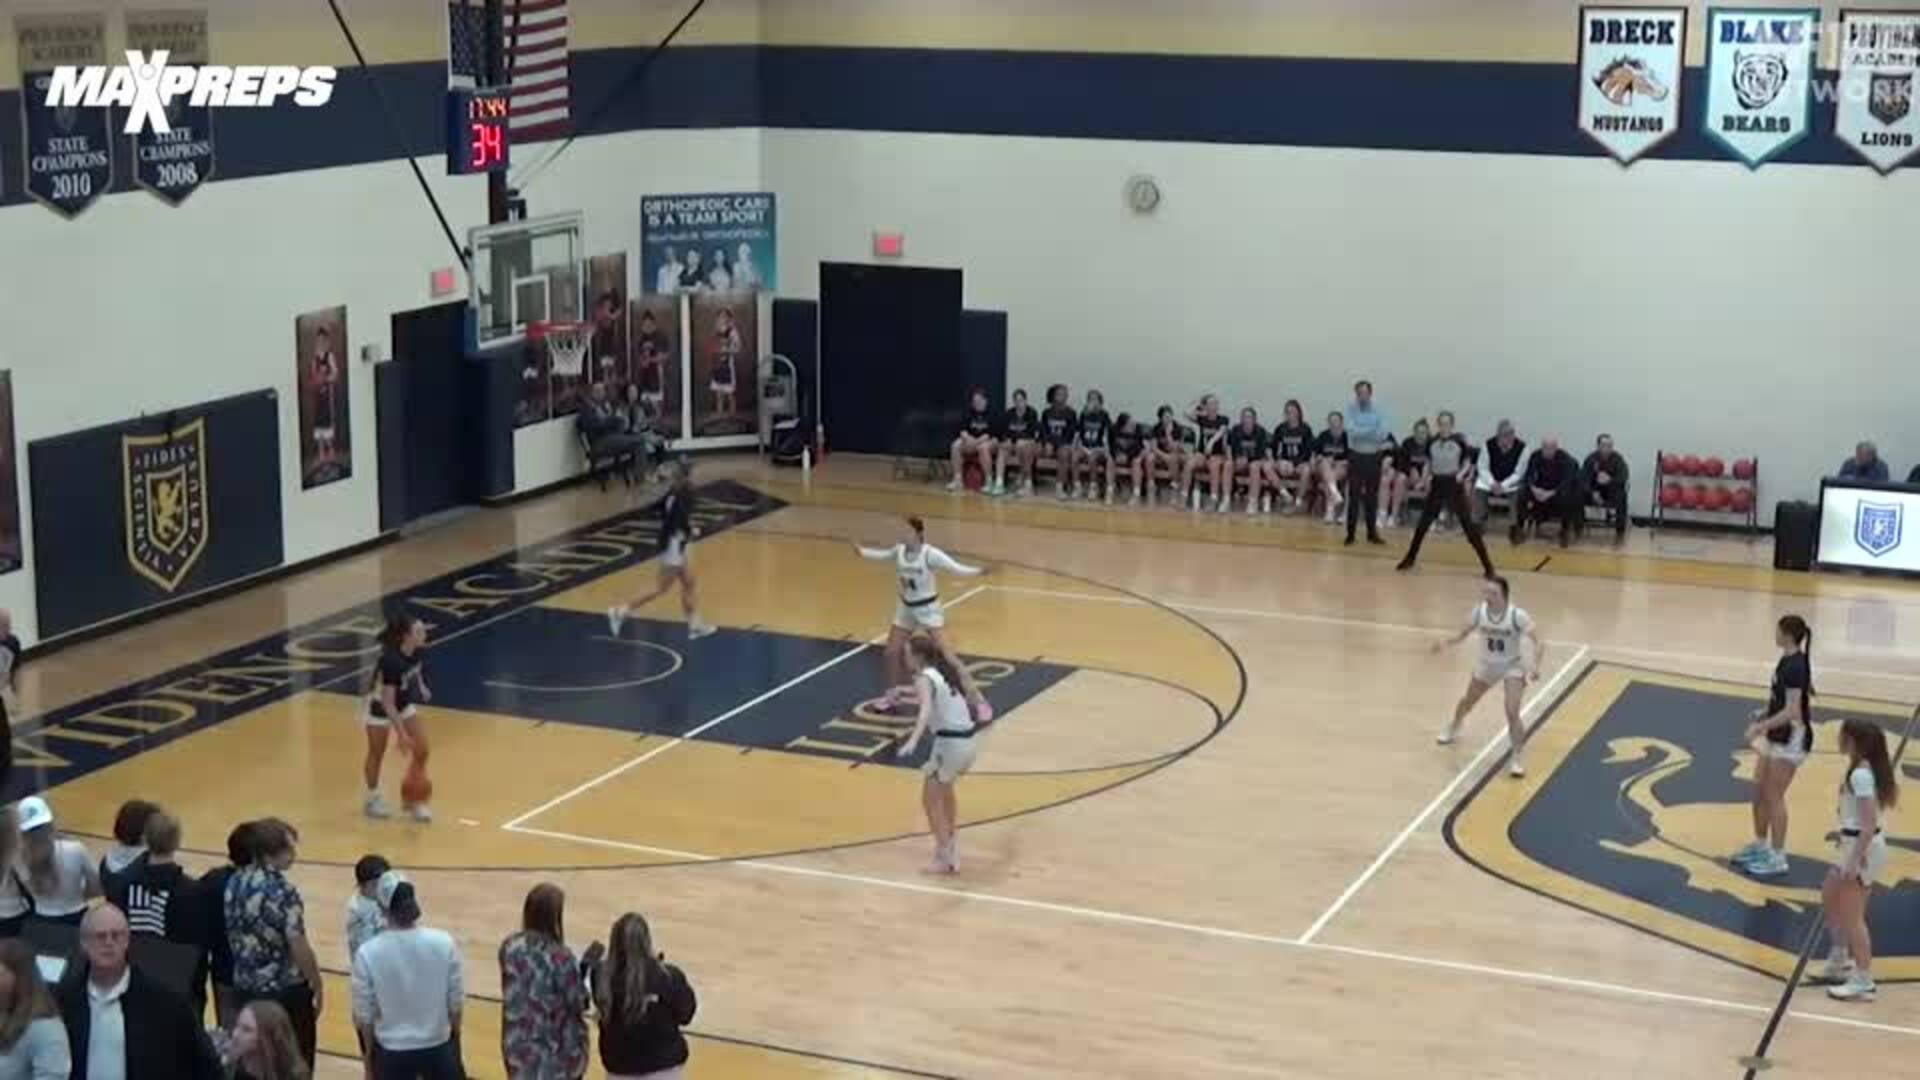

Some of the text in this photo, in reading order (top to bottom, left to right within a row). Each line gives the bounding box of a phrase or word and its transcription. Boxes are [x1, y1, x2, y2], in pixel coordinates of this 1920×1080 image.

[1589, 18, 1675, 45] BRECK
[1719, 19, 1803, 43] BLAKE
[1593, 115, 1663, 132] MUSTANGS
[1722, 114, 1791, 132] BEARS
[49, 136, 89, 153] STATE
[155, 127, 192, 144] STATE
[472, 123, 500, 166] 34
[1860, 132, 1913, 147] LIONS
[140, 140, 212, 161] CHAMPIONS
[32, 150, 109, 173] CHAMPIONS
[156, 162, 199, 187] 2008
[52, 172, 91, 200] 2010
[679, 210, 718, 225] TEAM
[720, 209, 765, 224] SPORT
